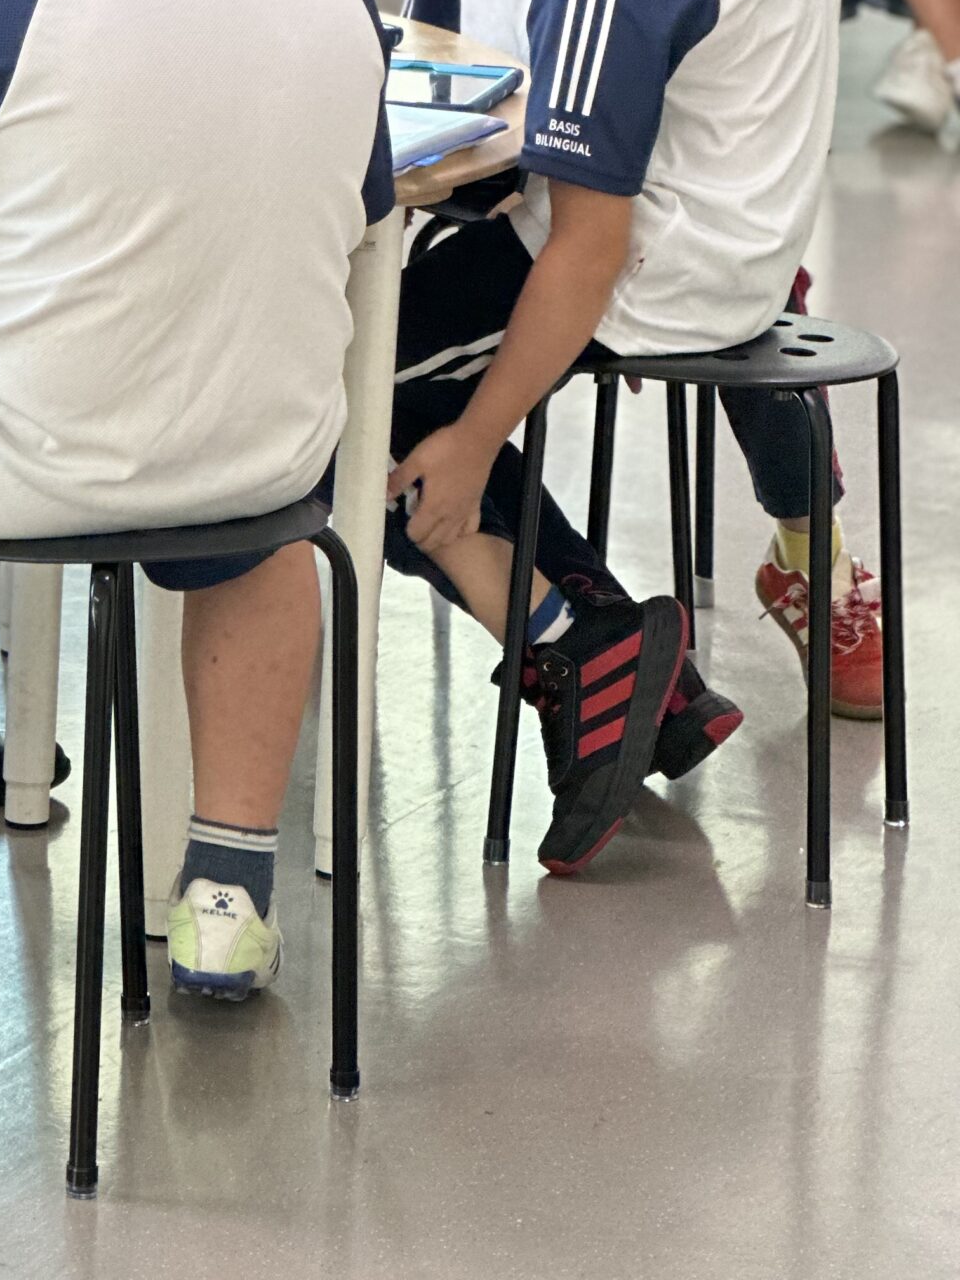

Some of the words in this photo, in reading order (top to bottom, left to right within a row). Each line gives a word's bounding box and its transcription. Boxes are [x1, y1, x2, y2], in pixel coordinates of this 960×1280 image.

[549, 119, 580, 136] BASIS
[536, 134, 591, 156] BILINGUAL
[202, 908, 237, 919] KELME
